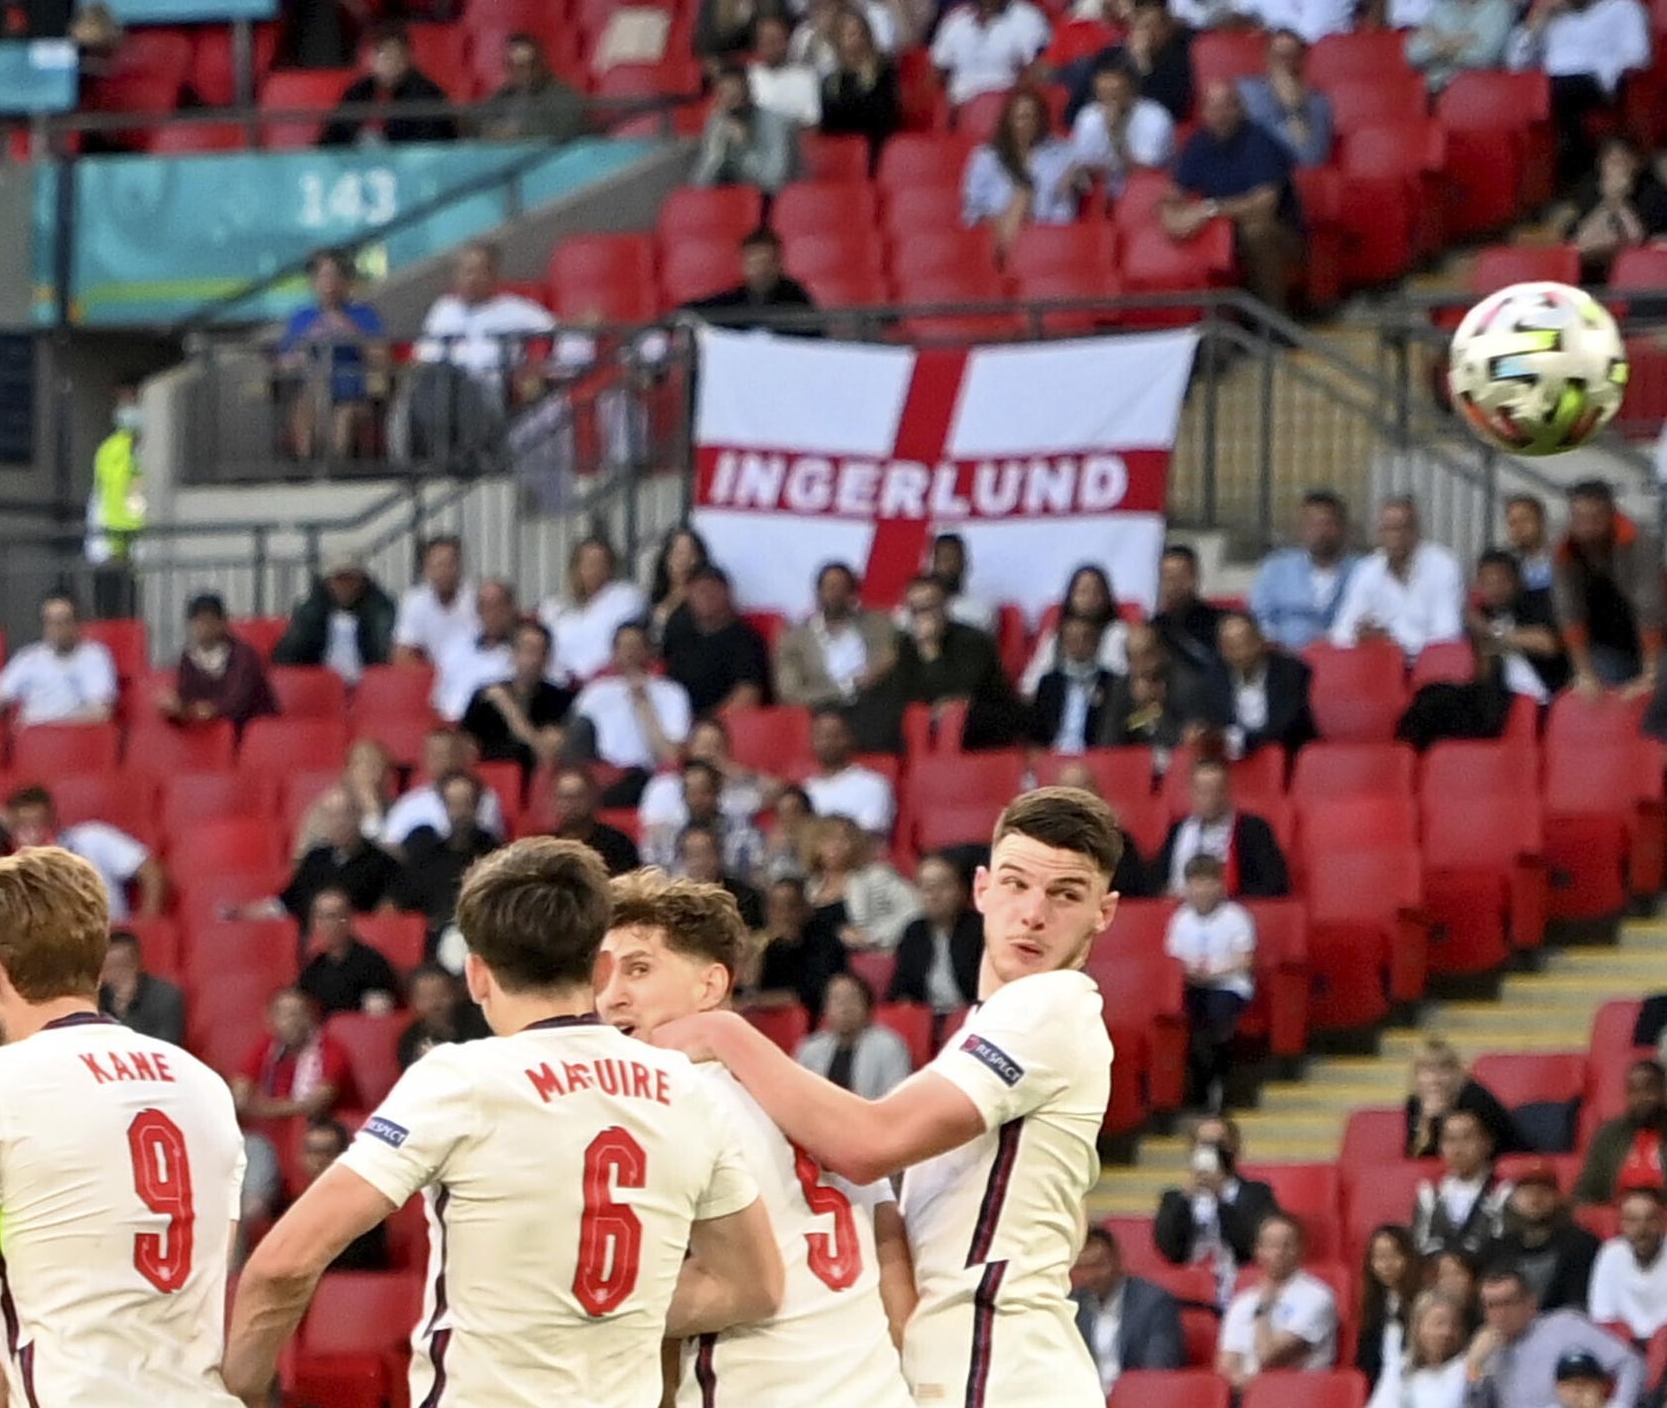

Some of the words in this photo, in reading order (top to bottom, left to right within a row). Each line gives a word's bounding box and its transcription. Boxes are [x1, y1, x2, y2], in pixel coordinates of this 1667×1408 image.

[299, 168, 397, 226] 143
[710, 452, 1131, 521] INGERLUND
[79, 1052, 176, 1084] KANE
[975, 1043, 1020, 1081] RESPECT
[128, 1108, 195, 1294] 9
[572, 1126, 646, 1316] 6
